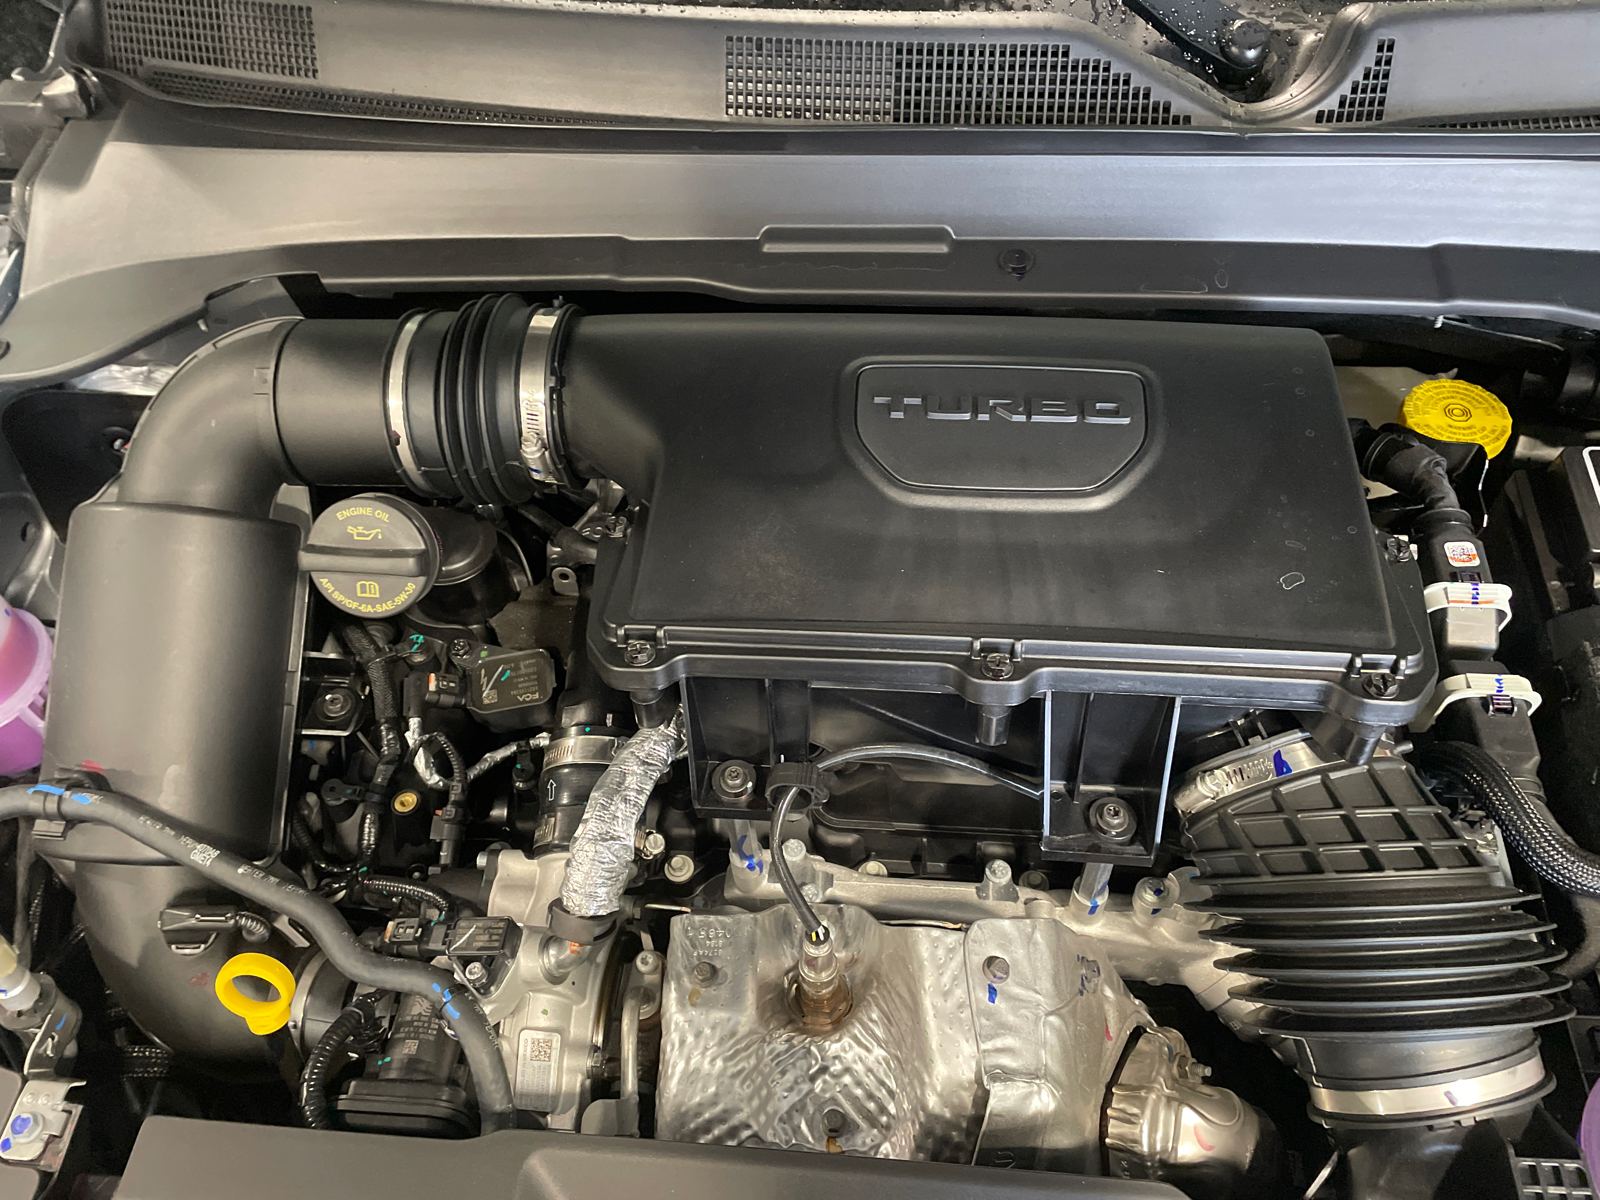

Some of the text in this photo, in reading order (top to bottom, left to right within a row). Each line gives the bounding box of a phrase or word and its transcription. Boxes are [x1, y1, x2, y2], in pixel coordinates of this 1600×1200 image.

[873, 394, 1131, 425] TURBO
[336, 507, 390, 523] ENGINE OIL
[319, 578, 334, 593] API
[517, 692, 539, 701] FCA
